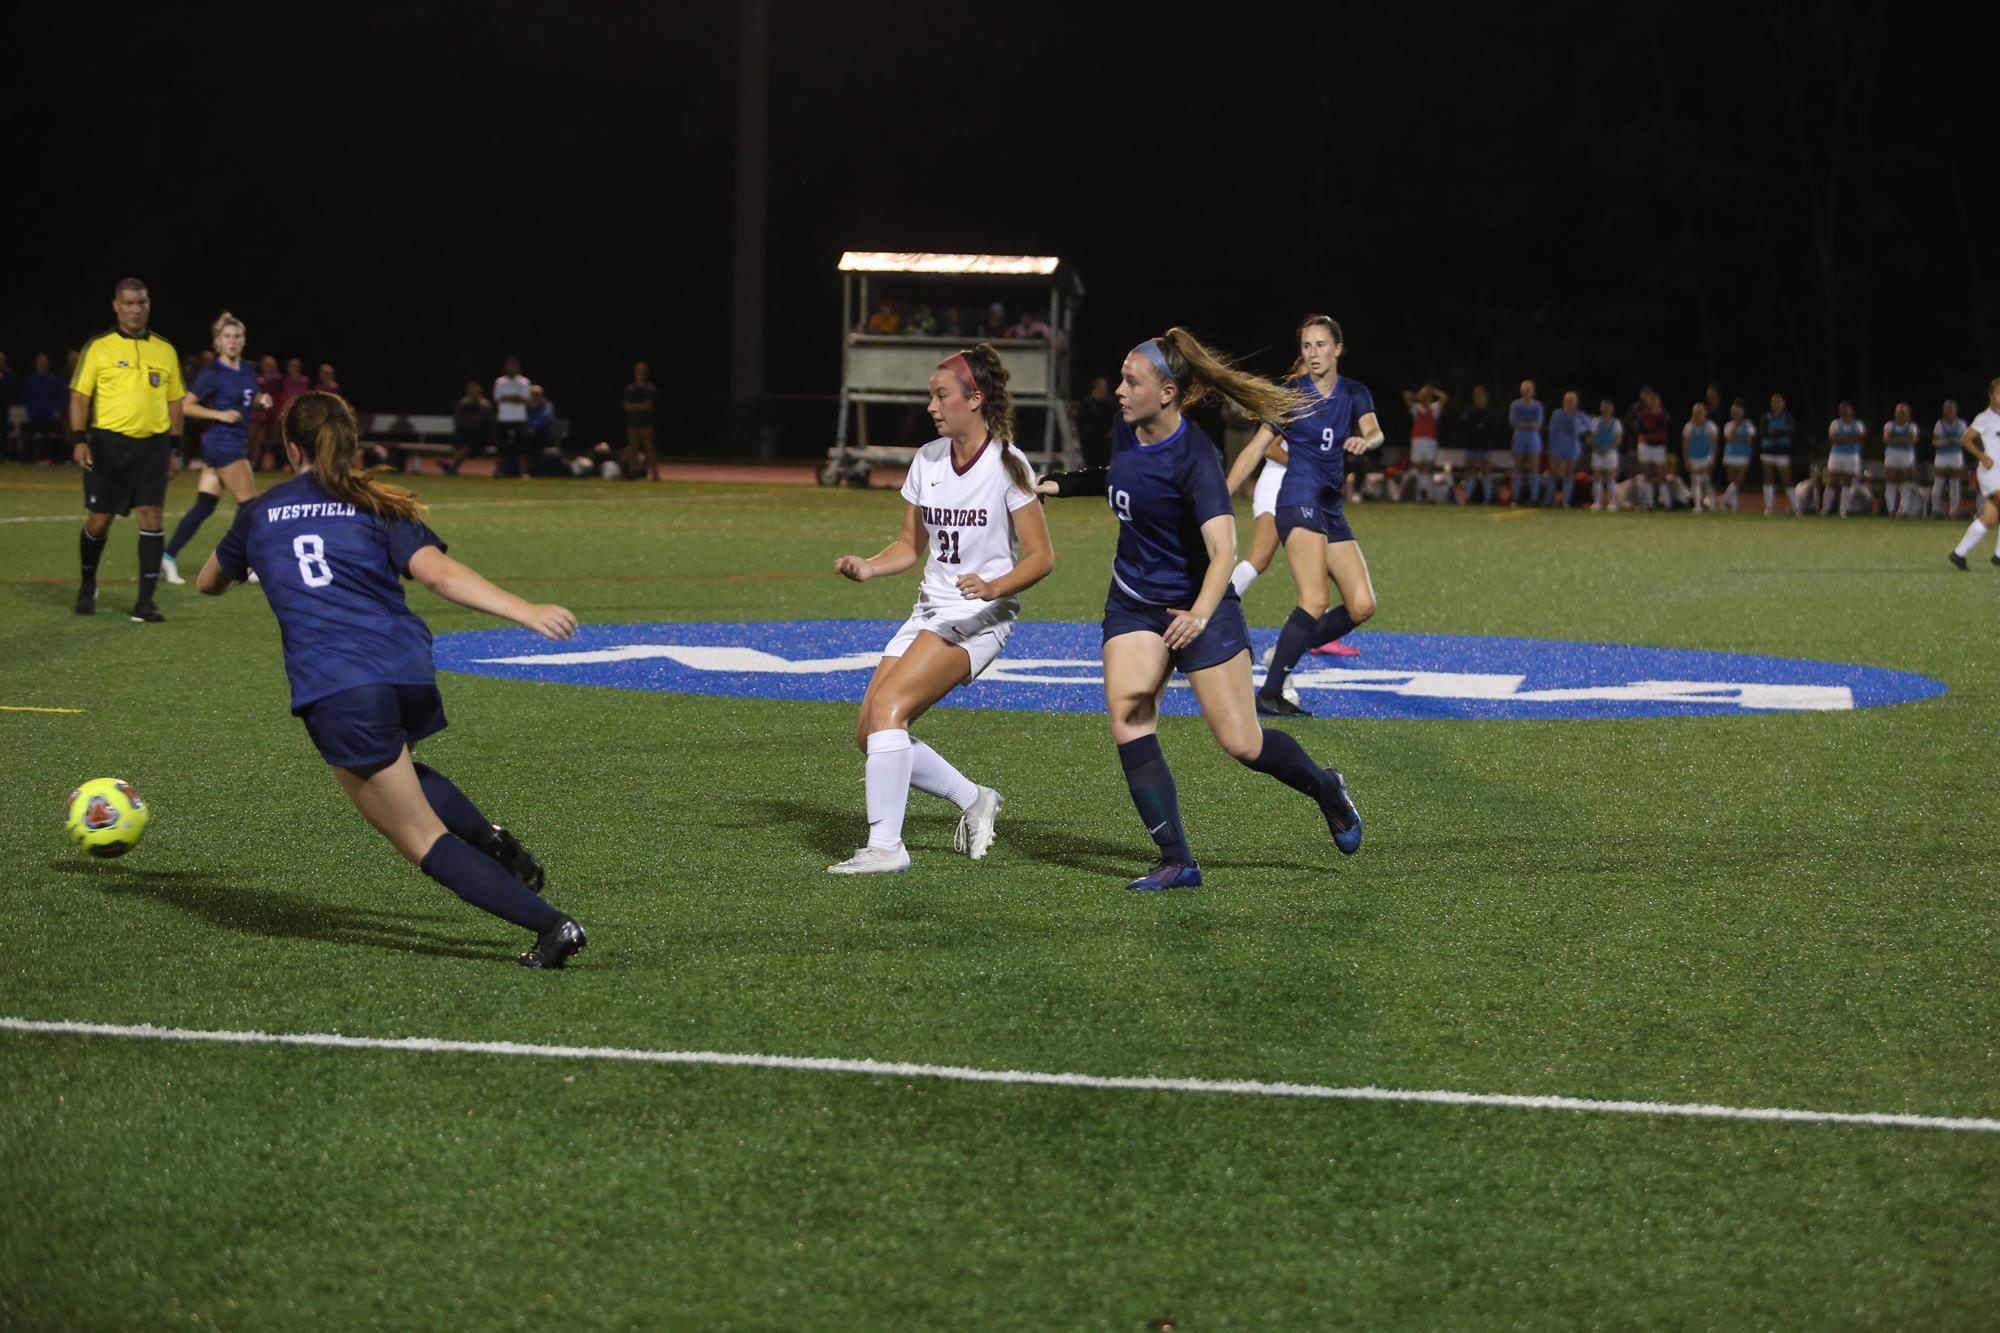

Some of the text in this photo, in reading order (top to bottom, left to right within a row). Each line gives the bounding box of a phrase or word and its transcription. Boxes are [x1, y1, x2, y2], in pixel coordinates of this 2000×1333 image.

[243, 389, 252, 407] 5
[1319, 427, 1334, 451] 9
[268, 502, 356, 523] WESTFIELD
[1107, 485, 1133, 521] 19
[293, 534, 334, 588] 8
[936, 530, 961, 565] 21
